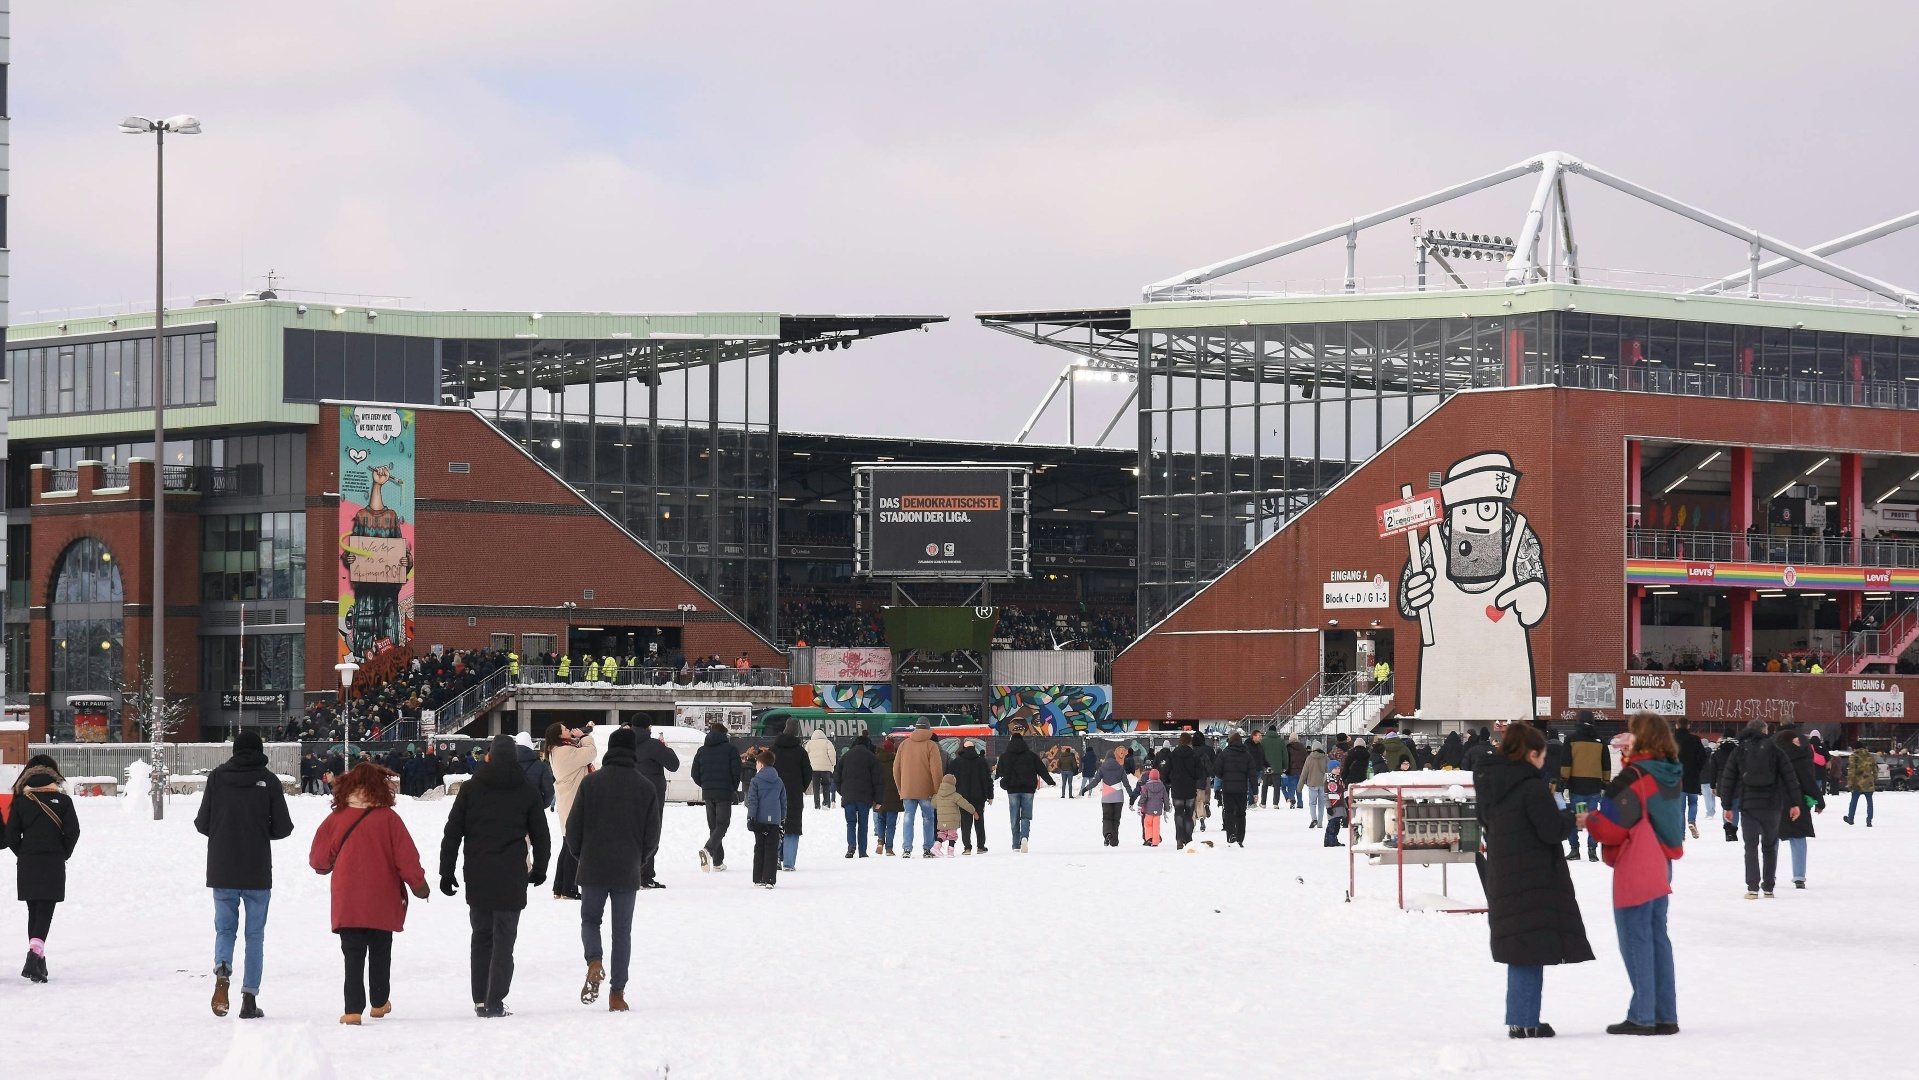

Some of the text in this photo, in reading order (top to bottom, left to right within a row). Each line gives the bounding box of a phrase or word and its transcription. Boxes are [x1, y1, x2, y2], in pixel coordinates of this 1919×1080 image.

[879, 497, 998, 509] DAS DEMOKRATISCHSTE
[880, 512, 971, 523] STADION DER LIGA.
[1387, 517, 1394, 528] 2
[1426, 505, 1432, 517] 1
[1330, 570, 1368, 581] EINGANG 4
[1325, 593, 1343, 603] Block
[1344, 593, 1349, 603] C
[1356, 593, 1361, 603] D
[1368, 593, 1373, 603] G
[1376, 592, 1387, 602] 1-3
[1358, 643, 1367, 652] WC
[1630, 675, 1665, 687] EINGANG 5
[1852, 680, 1885, 690] EINGANG 6
[1625, 699, 1643, 709] Block
[1644, 700, 1648, 709] C
[1655, 700, 1660, 709] D
[1666, 700, 1671, 709] G
[1847, 702, 1864, 712] Block
[1865, 702, 1869, 712] C
[1875, 702, 1880, 712] D
[1886, 702, 1891, 712] G
[800, 719, 868, 736] WERDER
